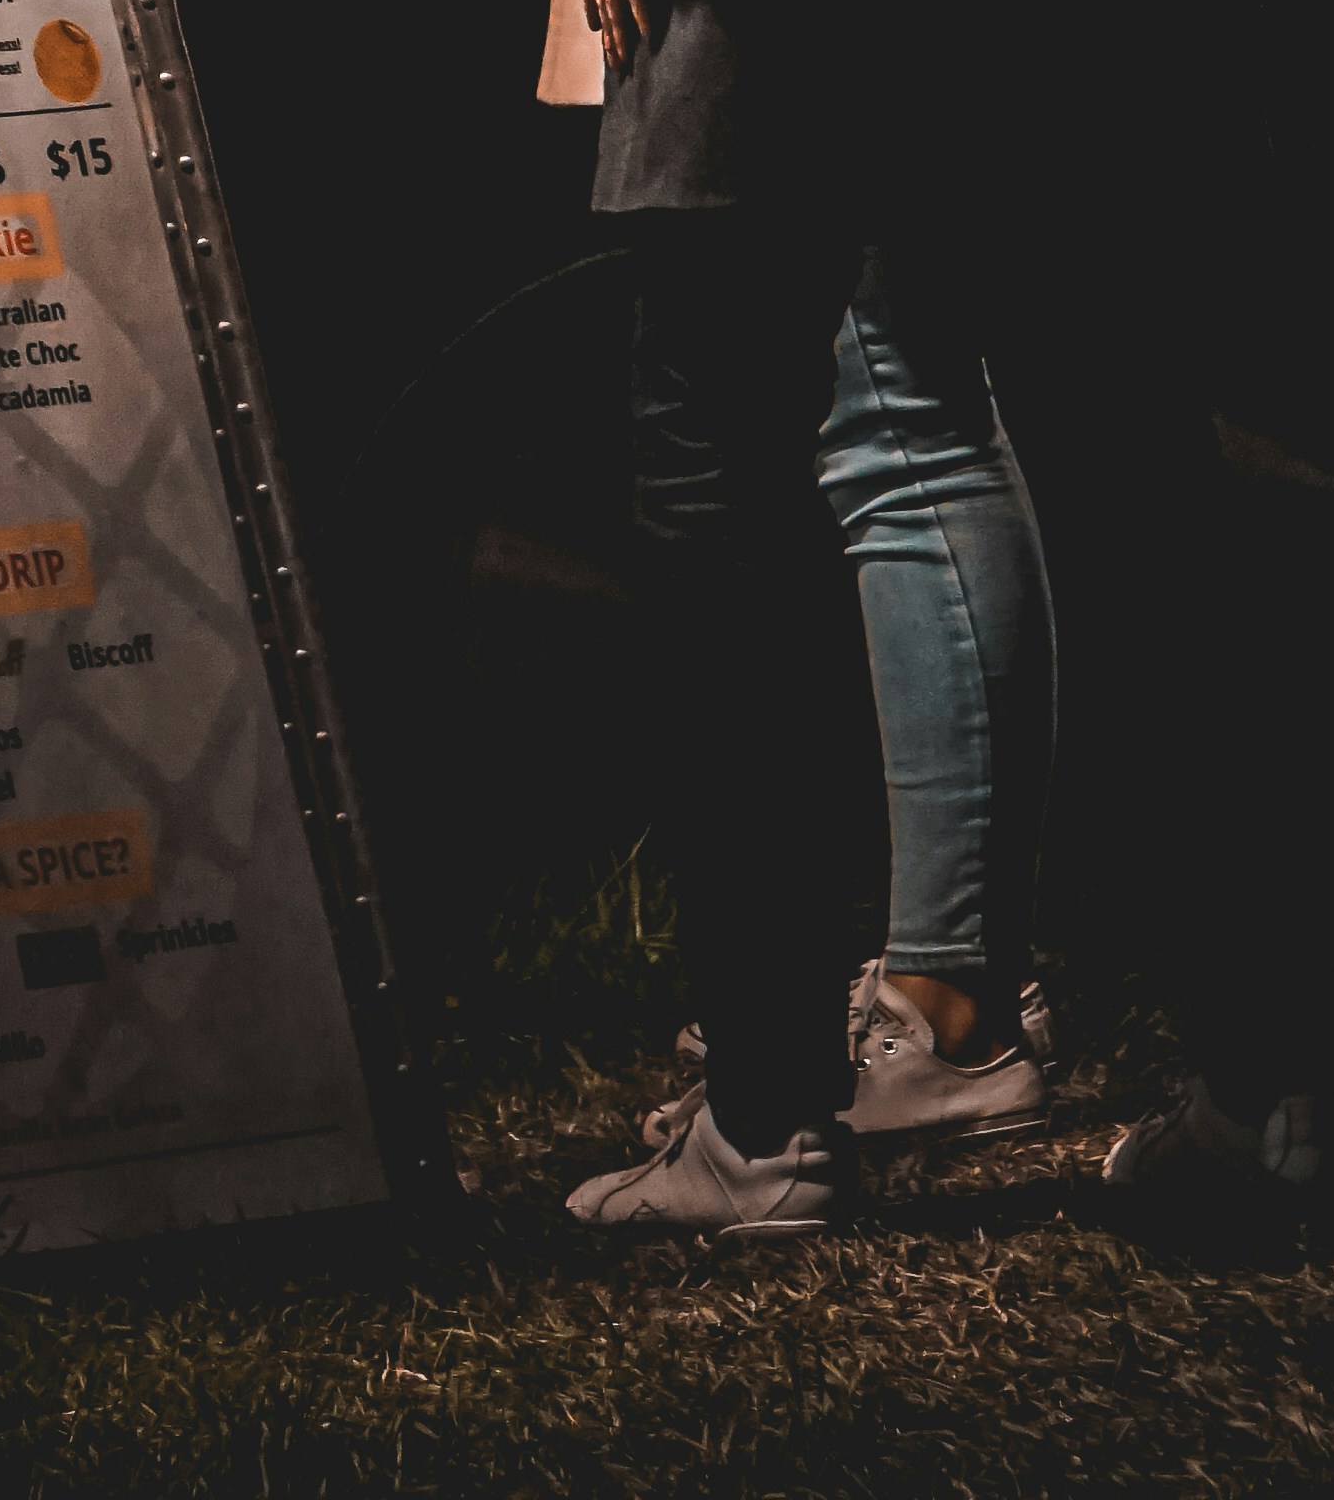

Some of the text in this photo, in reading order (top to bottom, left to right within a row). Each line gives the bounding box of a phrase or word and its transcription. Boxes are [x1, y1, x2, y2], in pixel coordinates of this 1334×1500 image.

[45, 137, 114, 183] $15
[25, 339, 81, 367] Choc
[68, 632, 155, 671] Biscoff
[20, 836, 131, 887] SPICE?
[114, 915, 239, 964] Sprinkles
